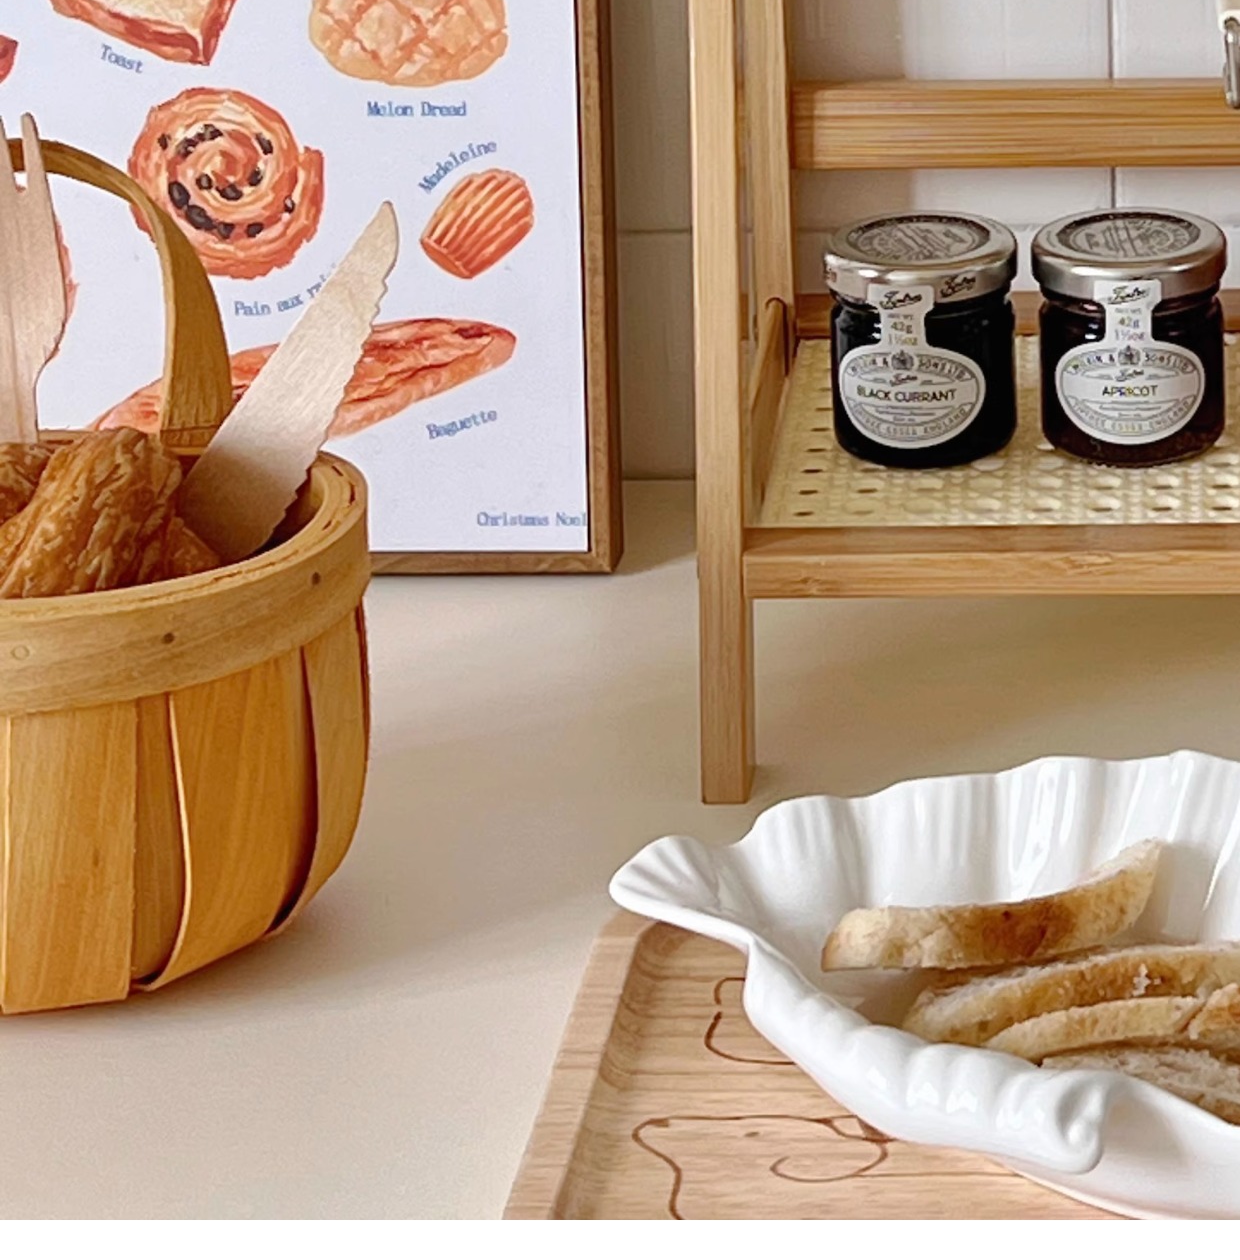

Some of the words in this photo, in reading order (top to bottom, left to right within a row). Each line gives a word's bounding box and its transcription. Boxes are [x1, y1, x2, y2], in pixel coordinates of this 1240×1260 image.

[100, 43, 143, 74] Toast
[367, 101, 415, 116] Melon
[418, 141, 497, 194] Madeleine
[234, 301, 271, 316] Pain
[857, 385, 891, 401] BLACK
[895, 389, 957, 402] CURRANT
[1102, 385, 1158, 397] APRICOT
[426, 410, 497, 439] Baguette
[477, 512, 549, 526] Christmas
[555, 512, 587, 526] Noel
